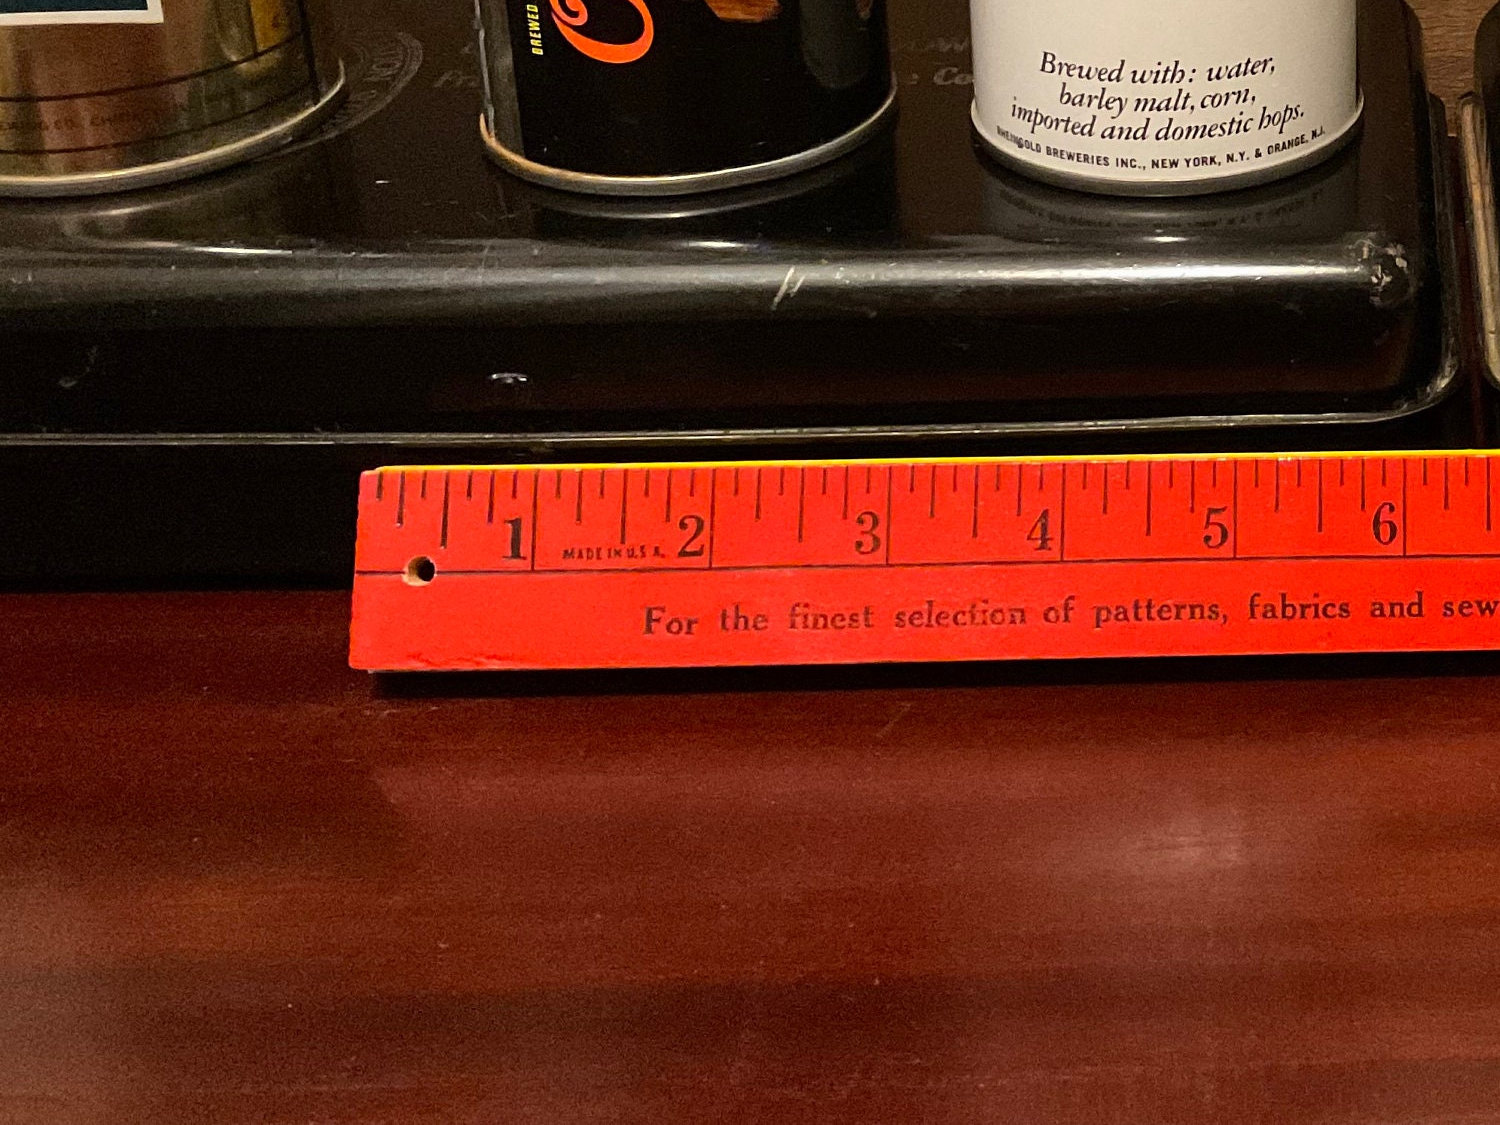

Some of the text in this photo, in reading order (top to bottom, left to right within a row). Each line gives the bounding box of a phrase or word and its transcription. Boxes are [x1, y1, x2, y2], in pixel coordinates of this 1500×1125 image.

[526, 4, 544, 56] BREWED
[1040, 51, 1275, 85] Brewed with: water,
[1011, 96, 1304, 142] imported and domestic hops.
[1059, 82, 1256, 119] barley malt, corn,
[1046, 145, 1110, 167] BREWERIES
[1151, 159, 1179, 169] NEW
[1184, 155, 1222, 168] YORK,
[1226, 151, 1250, 163] N.Y.
[1254, 147, 1262, 159] &
[501, 517, 528, 561] 1
[677, 514, 706, 558] 2
[855, 511, 882, 555] 3
[1026, 508, 1054, 552] 4
[1202, 506, 1229, 550] 5
[1371, 501, 1398, 546] 6
[562, 546, 602, 561] MADE
[607, 546, 622, 560] IN
[642, 605, 699, 637] For
[719, 604, 768, 632] the
[789, 604, 873, 632] finest
[894, 598, 1026, 628] selection
[1042, 595, 1075, 625] of
[1093, 595, 1229, 630] patterns,
[1247, 593, 1351, 621] fabrics
[1369, 590, 1424, 619] and
